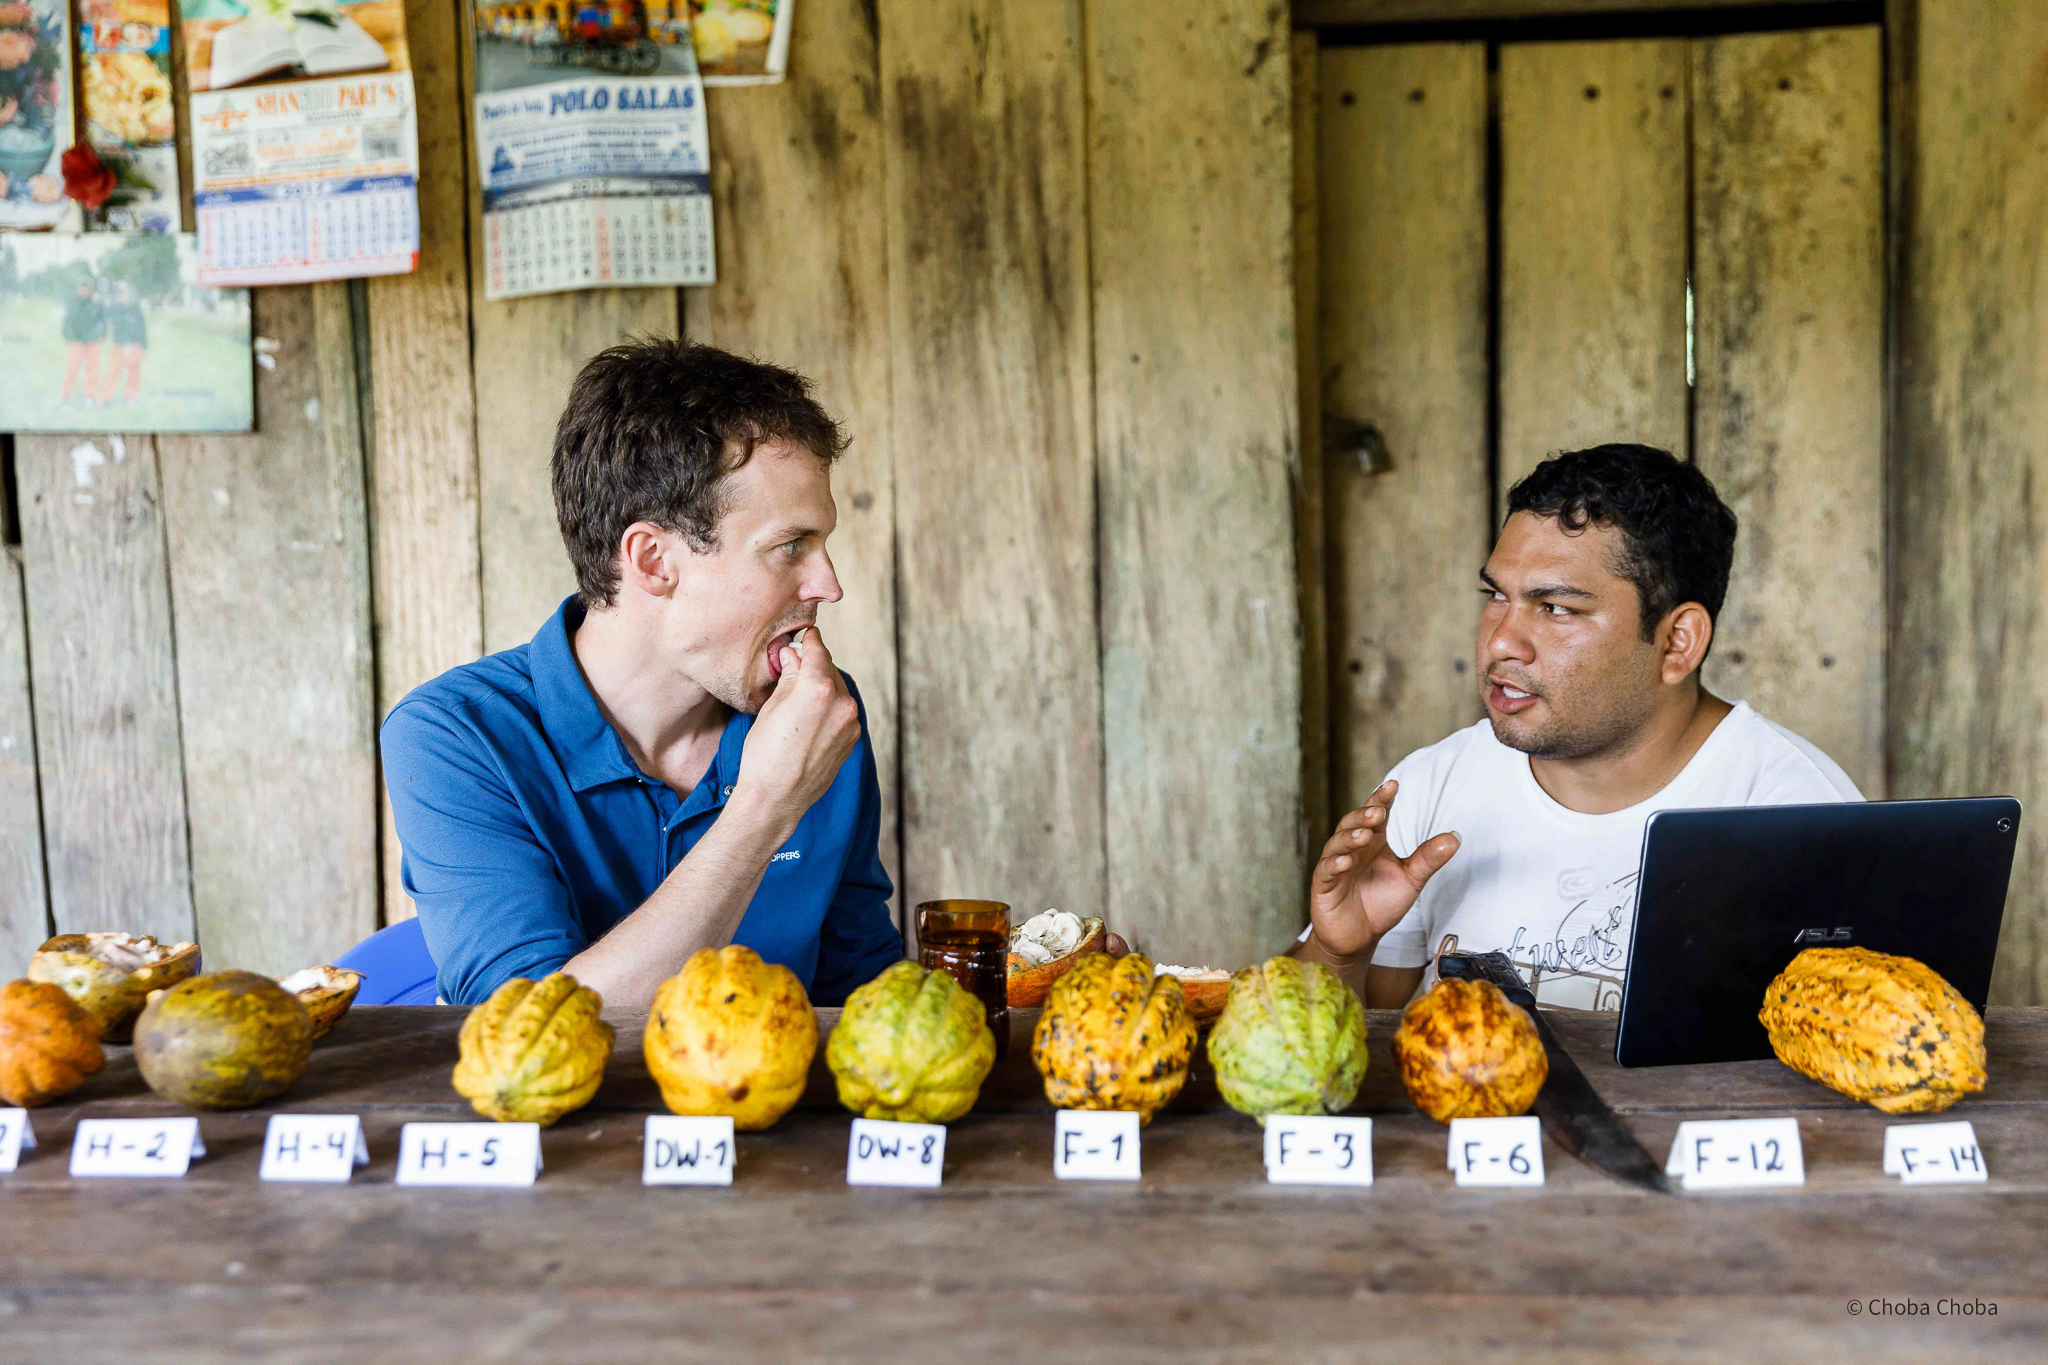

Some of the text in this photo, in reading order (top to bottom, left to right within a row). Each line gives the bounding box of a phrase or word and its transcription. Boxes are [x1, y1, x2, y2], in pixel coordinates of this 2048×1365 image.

[549, 87, 611, 115] POLO
[617, 85, 695, 110] SALAS
[87, 1131, 166, 1161] H-2
[279, 1130, 346, 1162] H-4
[420, 1138, 500, 1168] H-5
[857, 1134, 935, 1165] DW-8
[1279, 1131, 1354, 1168] F-3
[1465, 1142, 1531, 1175] F-6
[1696, 1138, 1784, 1171] F-12
[1900, 1143, 1980, 1173] F-14
